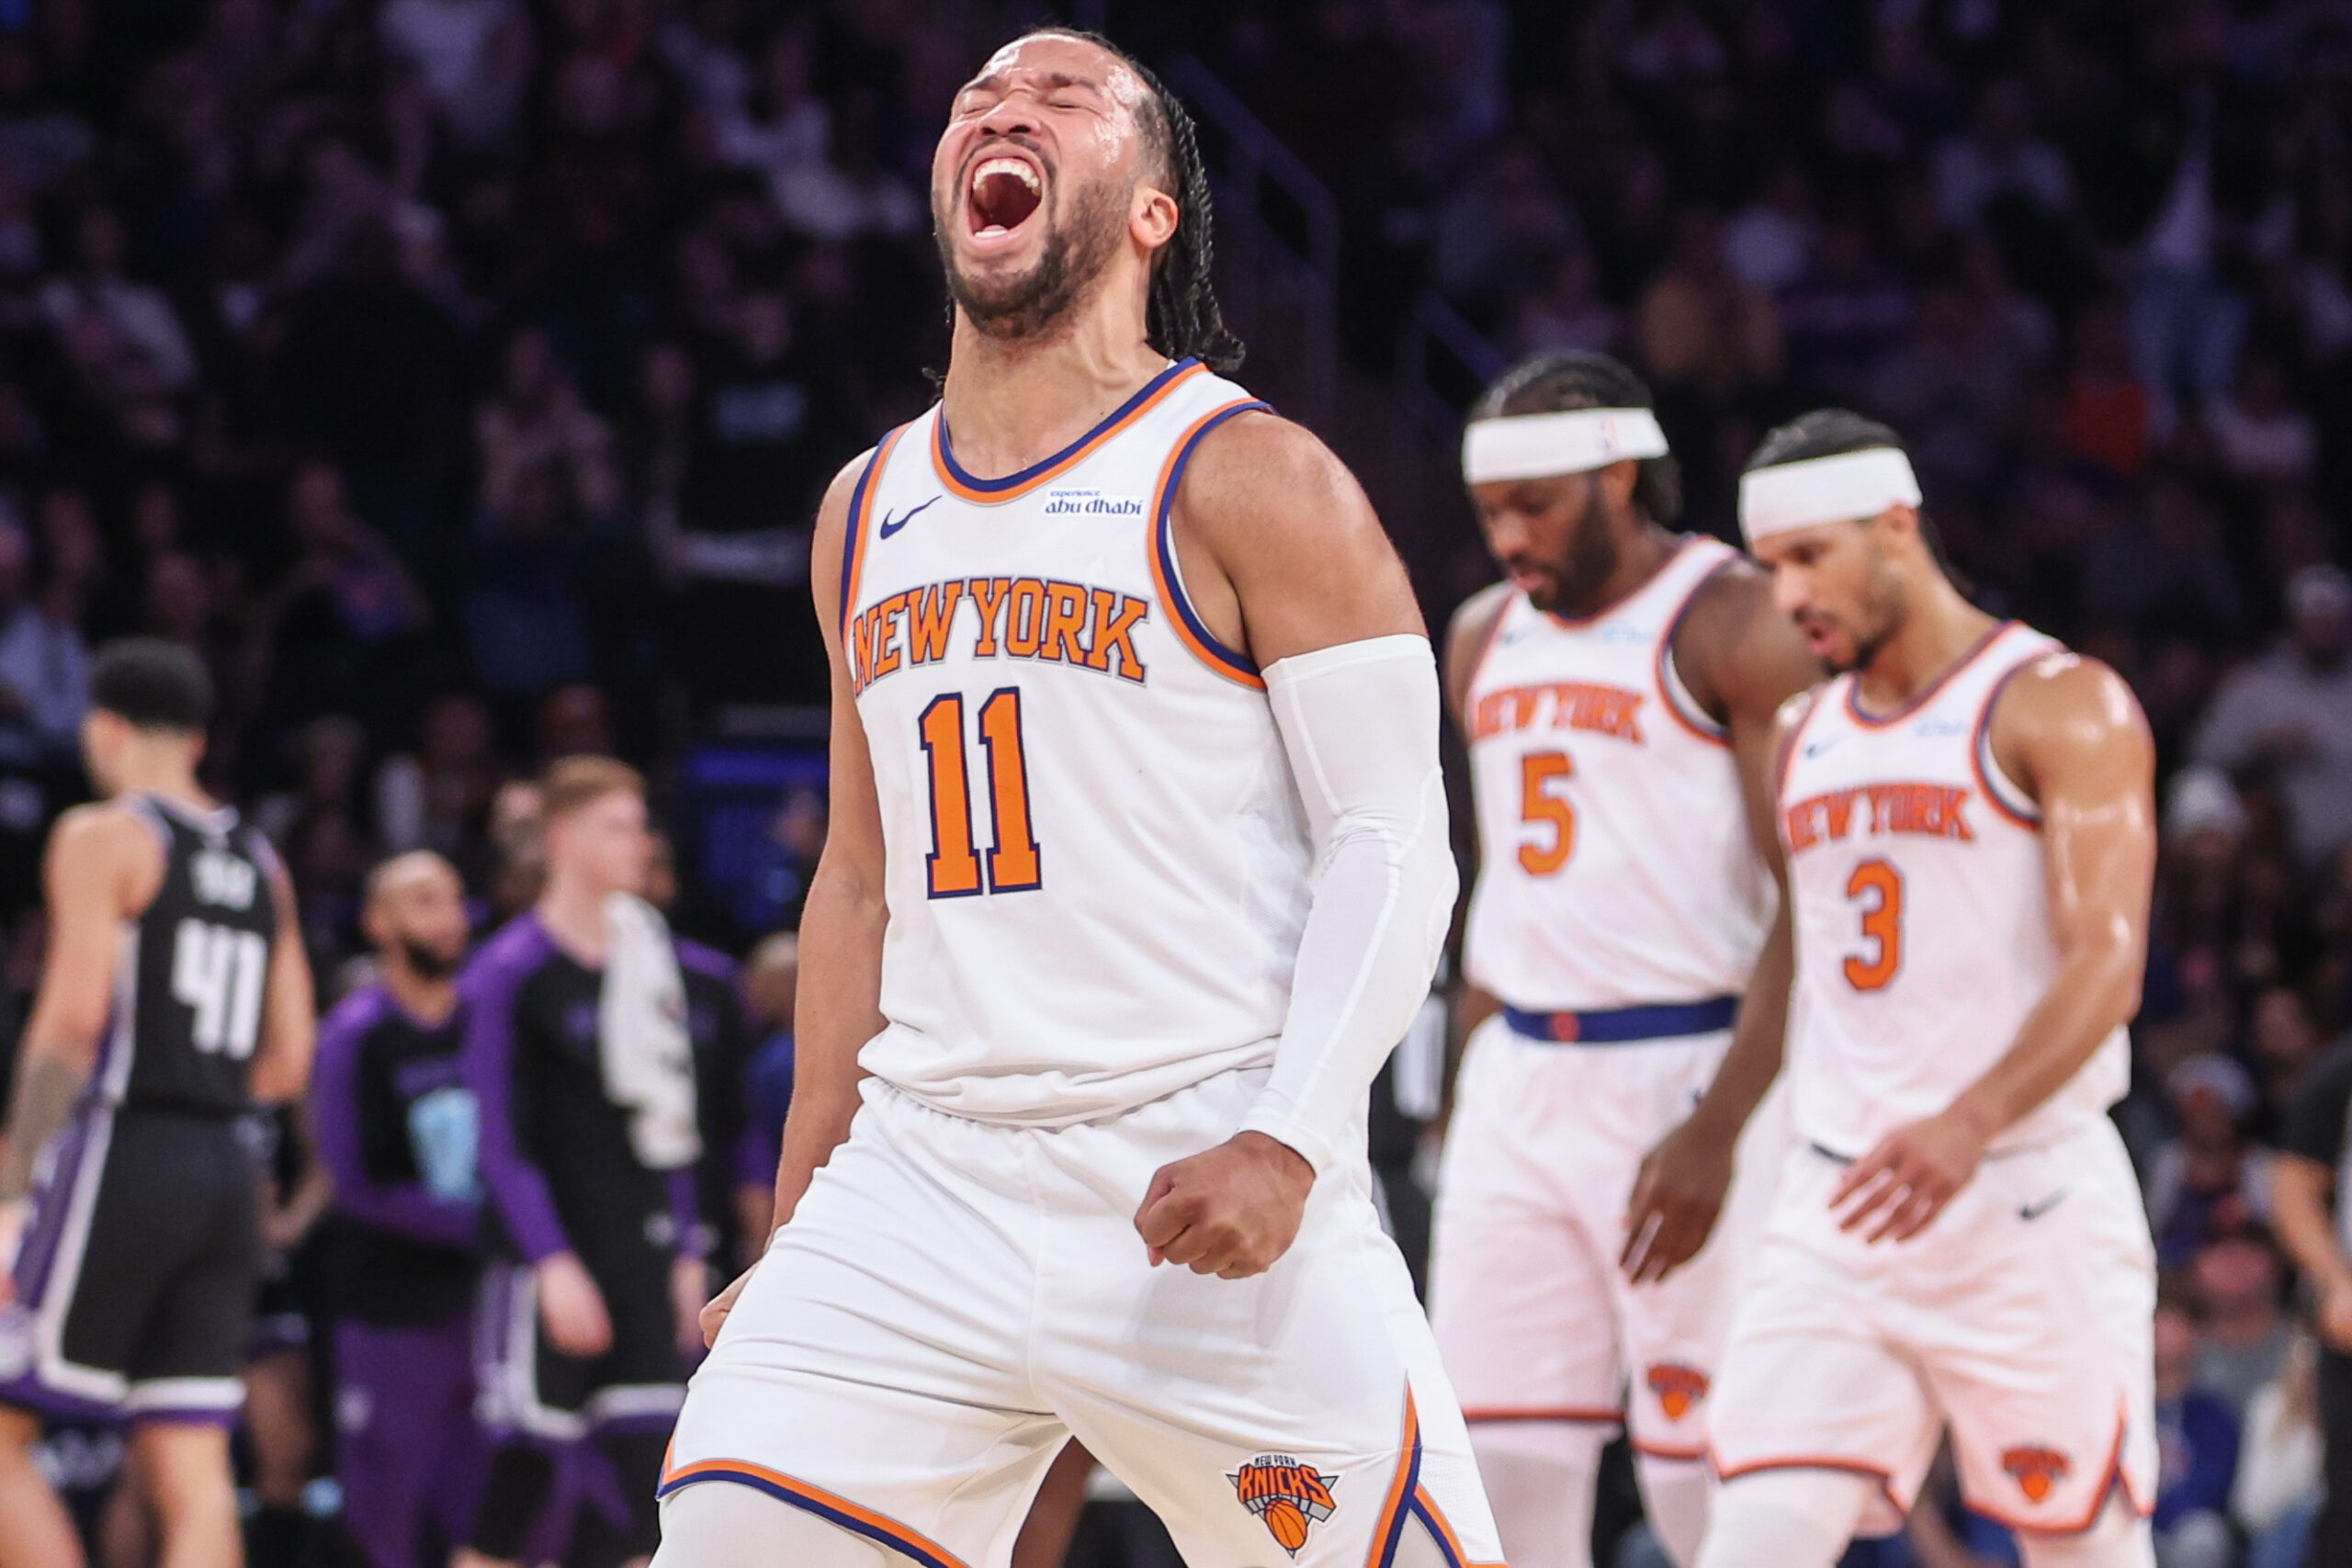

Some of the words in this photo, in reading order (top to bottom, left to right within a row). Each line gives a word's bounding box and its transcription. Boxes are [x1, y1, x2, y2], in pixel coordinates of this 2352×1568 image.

[1046, 499, 1081, 513] abu
[1085, 499, 1143, 515] dhabi
[1050, 490, 1101, 498] experience
[854, 580, 964, 698] NEW
[969, 577, 1148, 683] YORK
[1476, 685, 1539, 741] NEW
[1554, 682, 1646, 745] YORK
[919, 686, 1042, 899] 11
[1518, 752, 1576, 877] 5
[1789, 787, 1860, 853] NEW
[1867, 783, 1974, 842] YORK
[1843, 860, 1905, 991] 3
[172, 918, 268, 1060] 41
[1238, 1463, 1337, 1511] KNICKS
[1255, 1455, 1272, 1466] NEW
[1273, 1455, 1297, 1468] YORK
